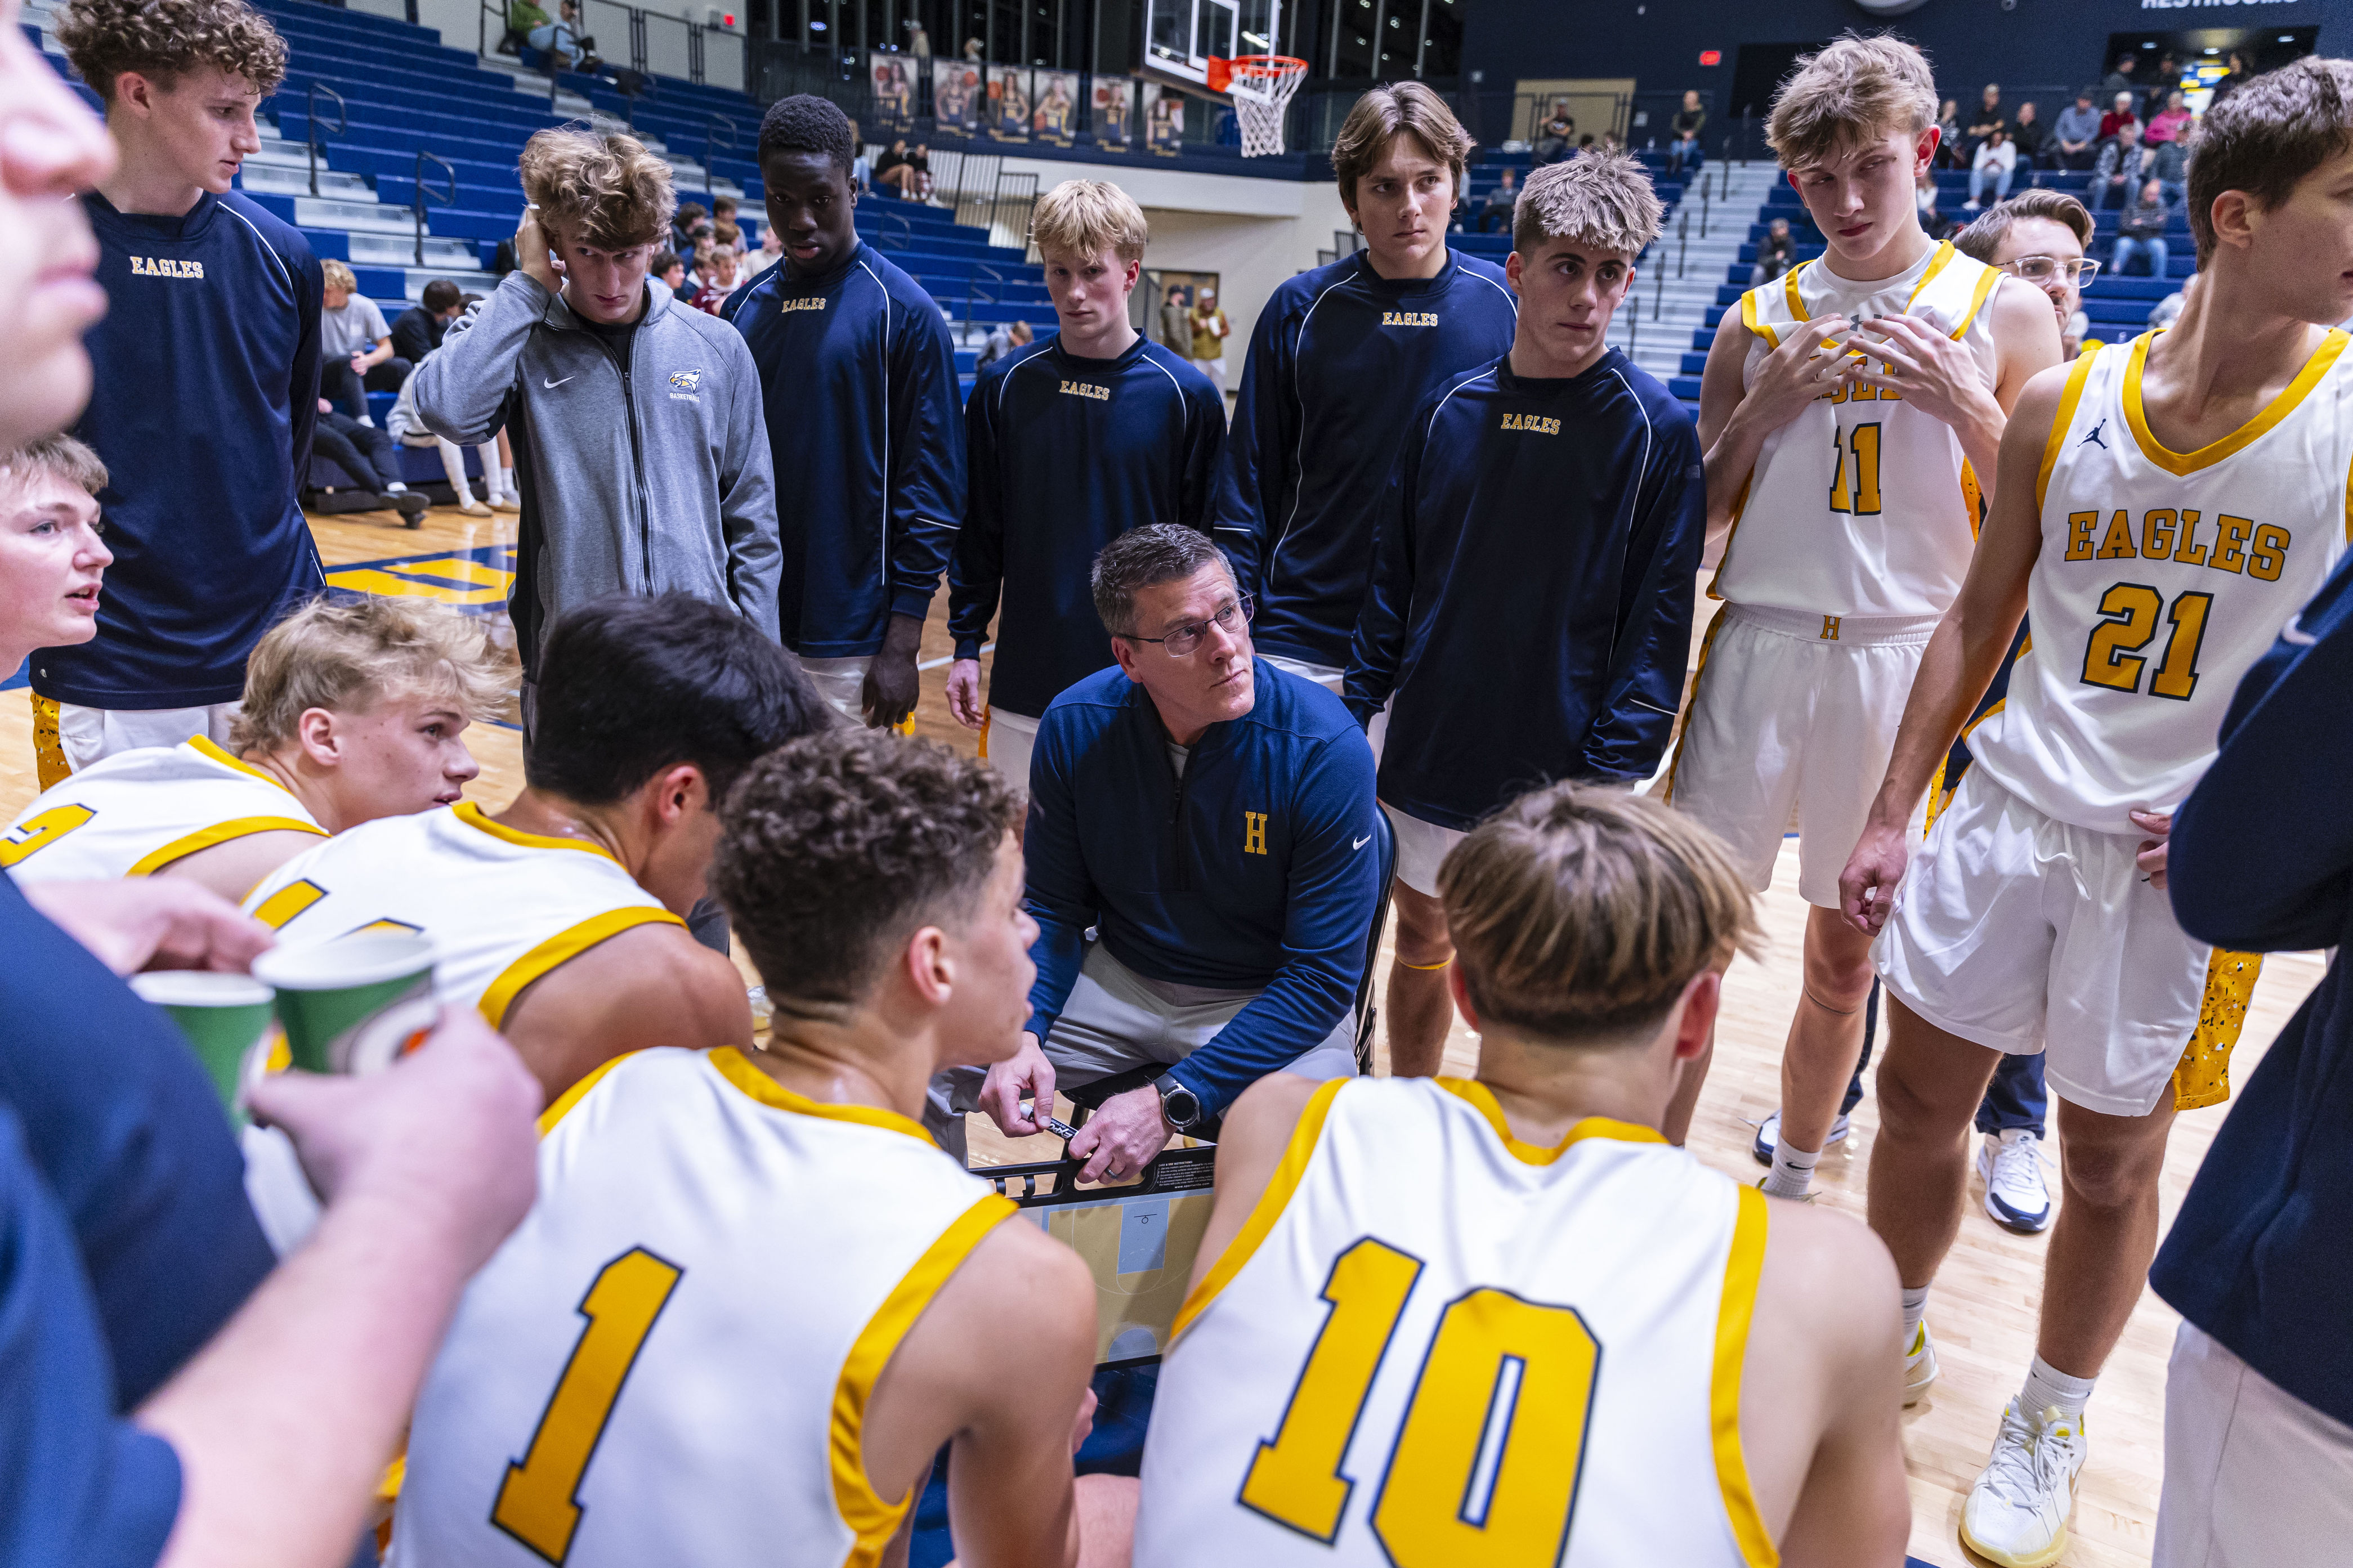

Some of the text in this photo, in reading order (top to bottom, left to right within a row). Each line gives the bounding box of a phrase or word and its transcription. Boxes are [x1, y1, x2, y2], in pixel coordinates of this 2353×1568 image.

[129, 256, 204, 279] EAGLES
[781, 298, 826, 313] EAGLES
[1382, 312, 1438, 326] EAGLES
[669, 392, 700, 402] BASKETBALL
[1059, 380, 1110, 401] EAGLES
[1501, 414, 1561, 434] EAGLES
[2064, 508, 2291, 582] EAGLES
[1820, 615, 1842, 640] H
[2079, 581, 2215, 702] 21
[1245, 811, 1267, 855] H
[489, 1242, 688, 1568] 1
[1235, 1233, 1603, 1568] 10
